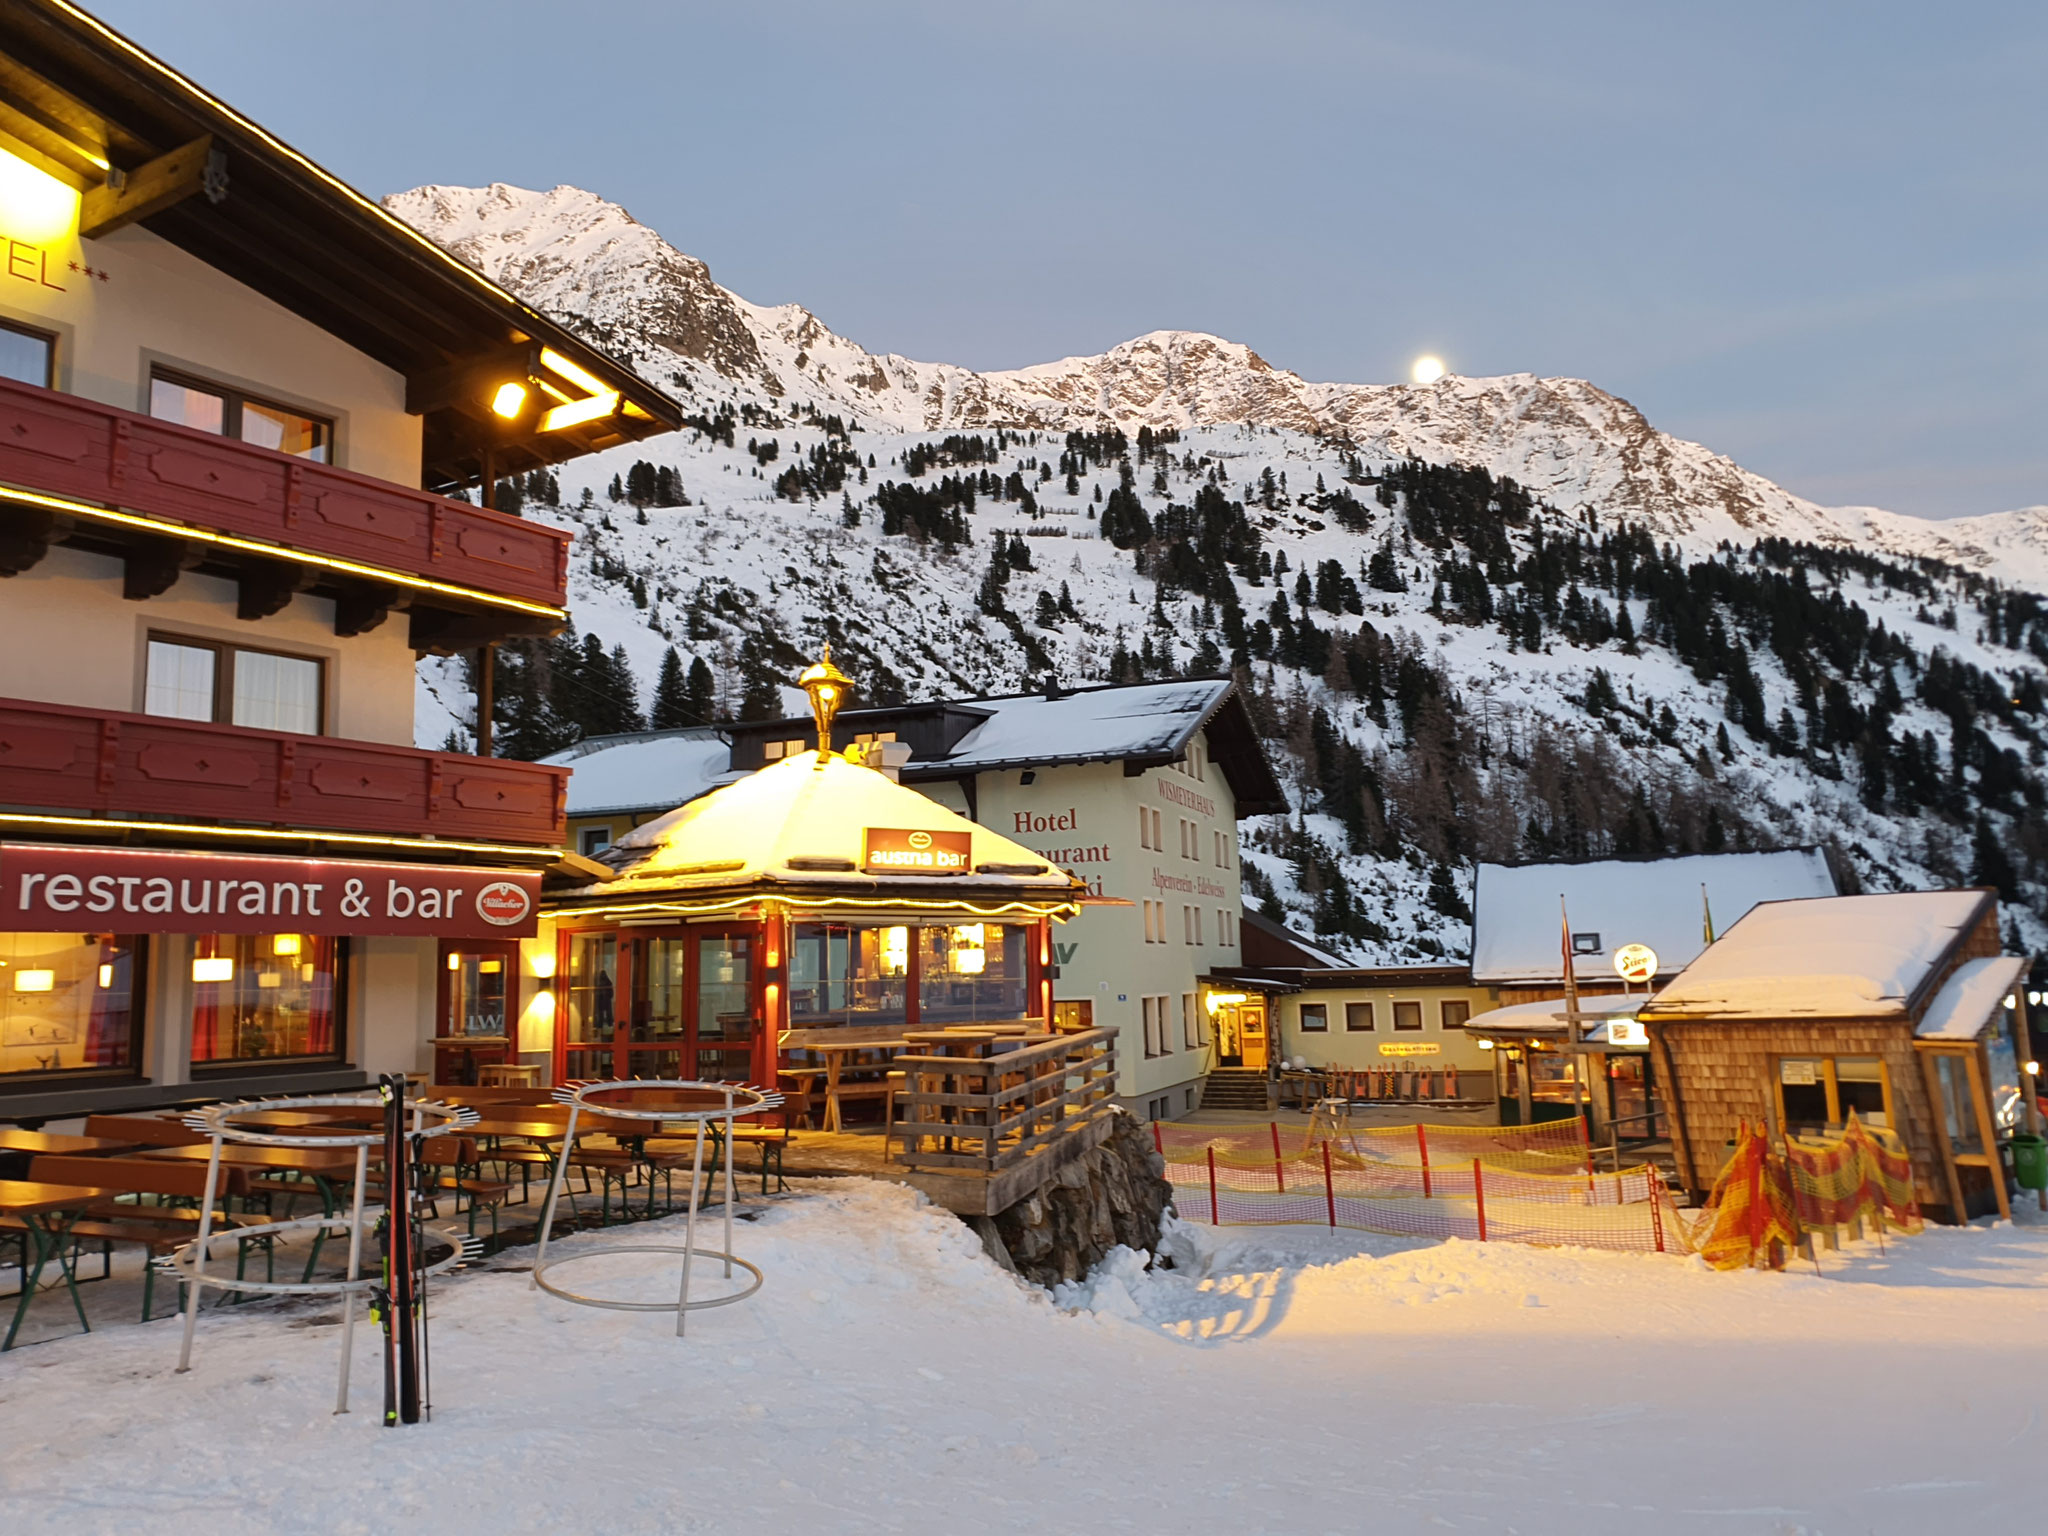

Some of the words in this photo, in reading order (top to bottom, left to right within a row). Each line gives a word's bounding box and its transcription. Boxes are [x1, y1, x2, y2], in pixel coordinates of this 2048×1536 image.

[0, 236, 66, 292] EL
[1013, 808, 1077, 833] Hotel
[937, 851, 968, 866] bar
[19, 872, 323, 916] restaurant
[339, 878, 371, 918] &
[386, 879, 463, 918] bar
